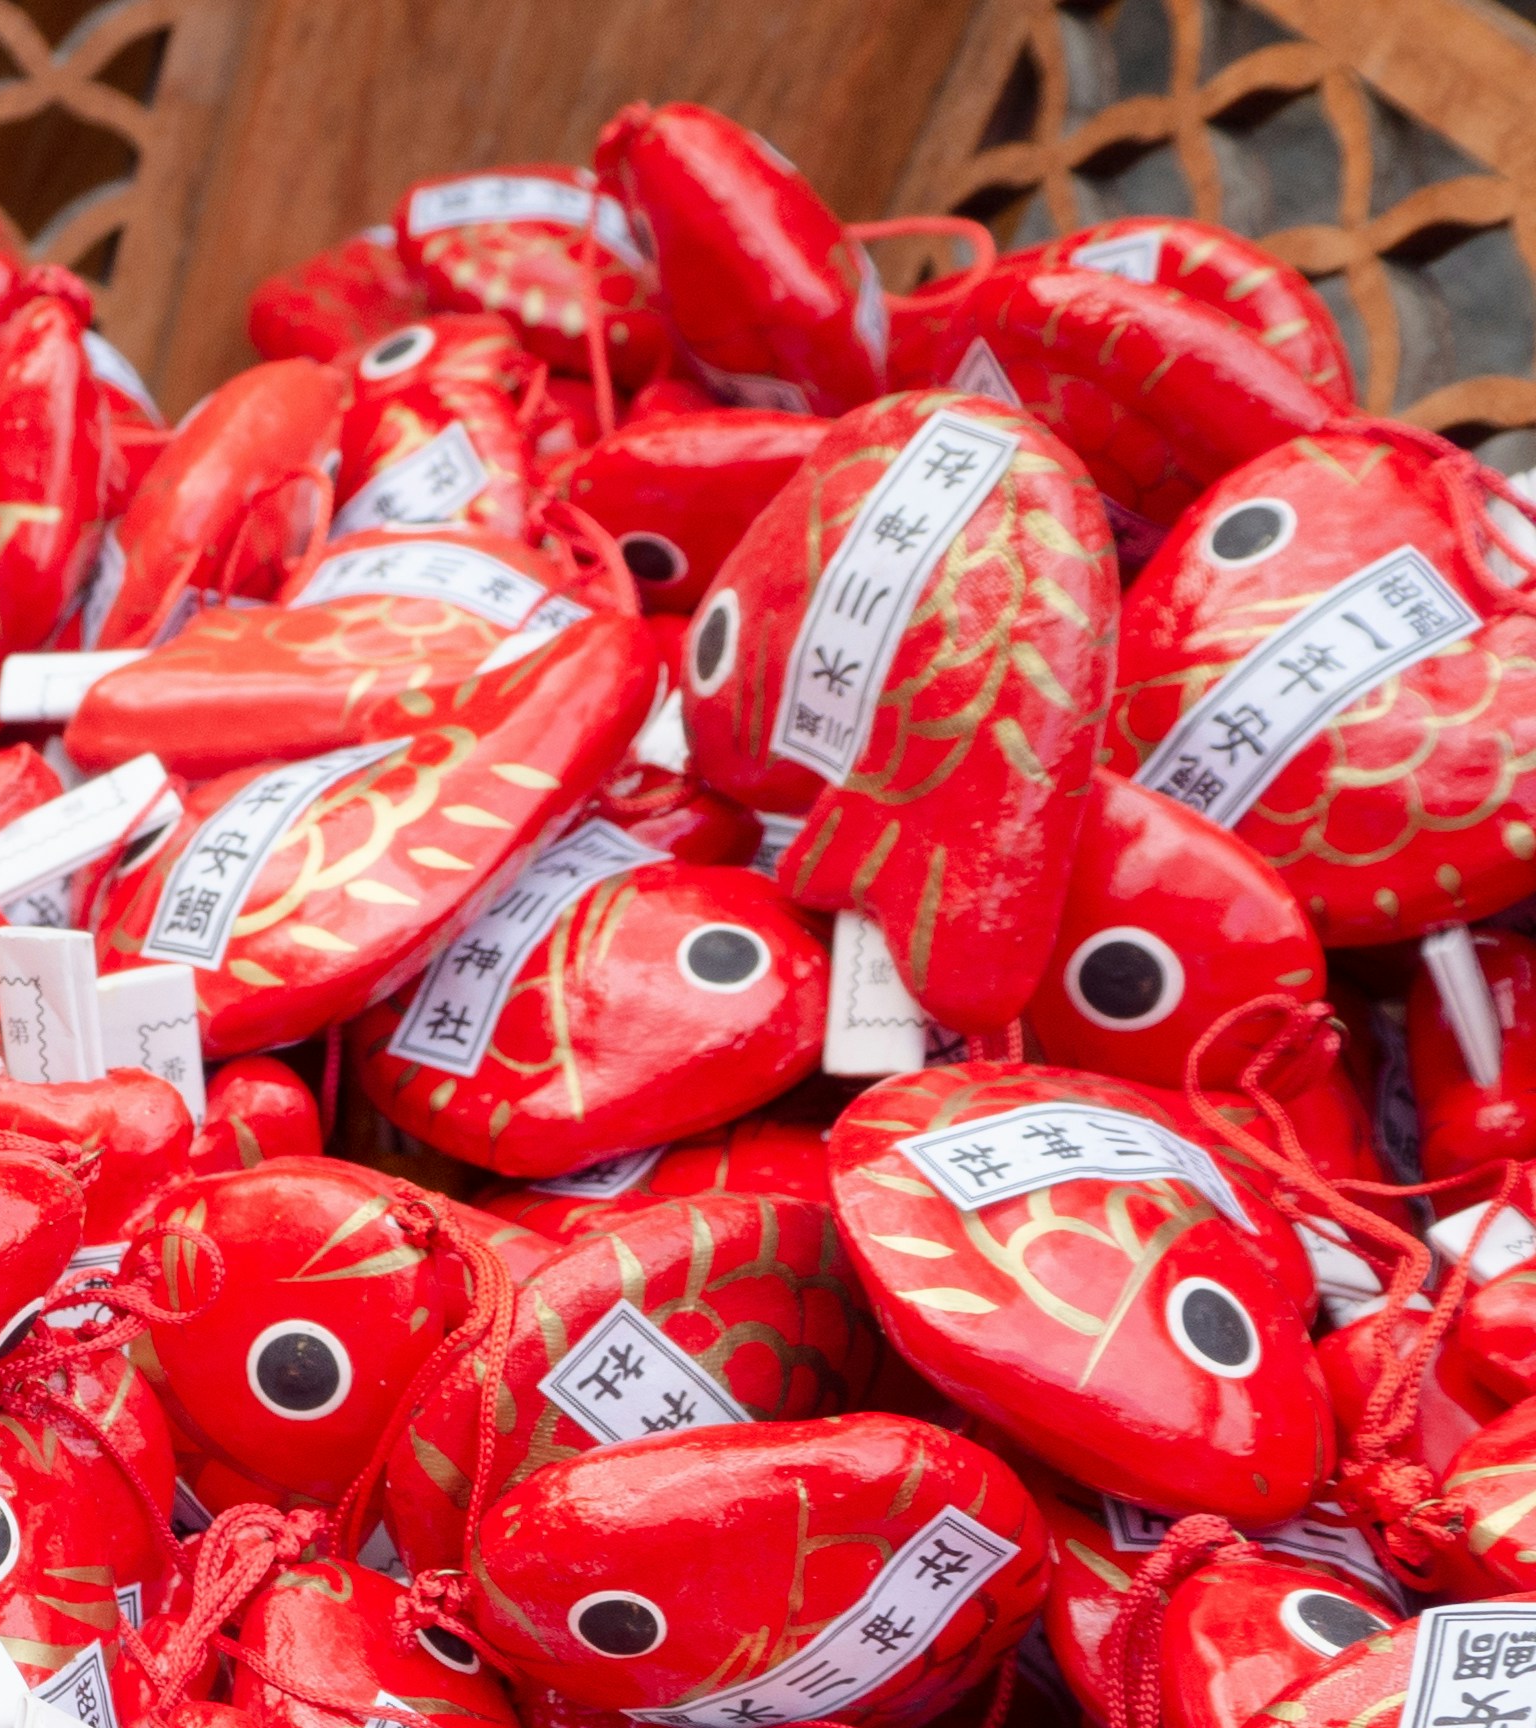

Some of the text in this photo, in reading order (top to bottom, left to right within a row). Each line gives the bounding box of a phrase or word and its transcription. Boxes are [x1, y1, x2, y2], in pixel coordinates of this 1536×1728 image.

[812, 440, 980, 699] 氷川神社
[1376, 570, 1449, 638] 招福
[427, 855, 581, 1049] 氷川神社
[721, 1540, 974, 1725] 氷川神社
